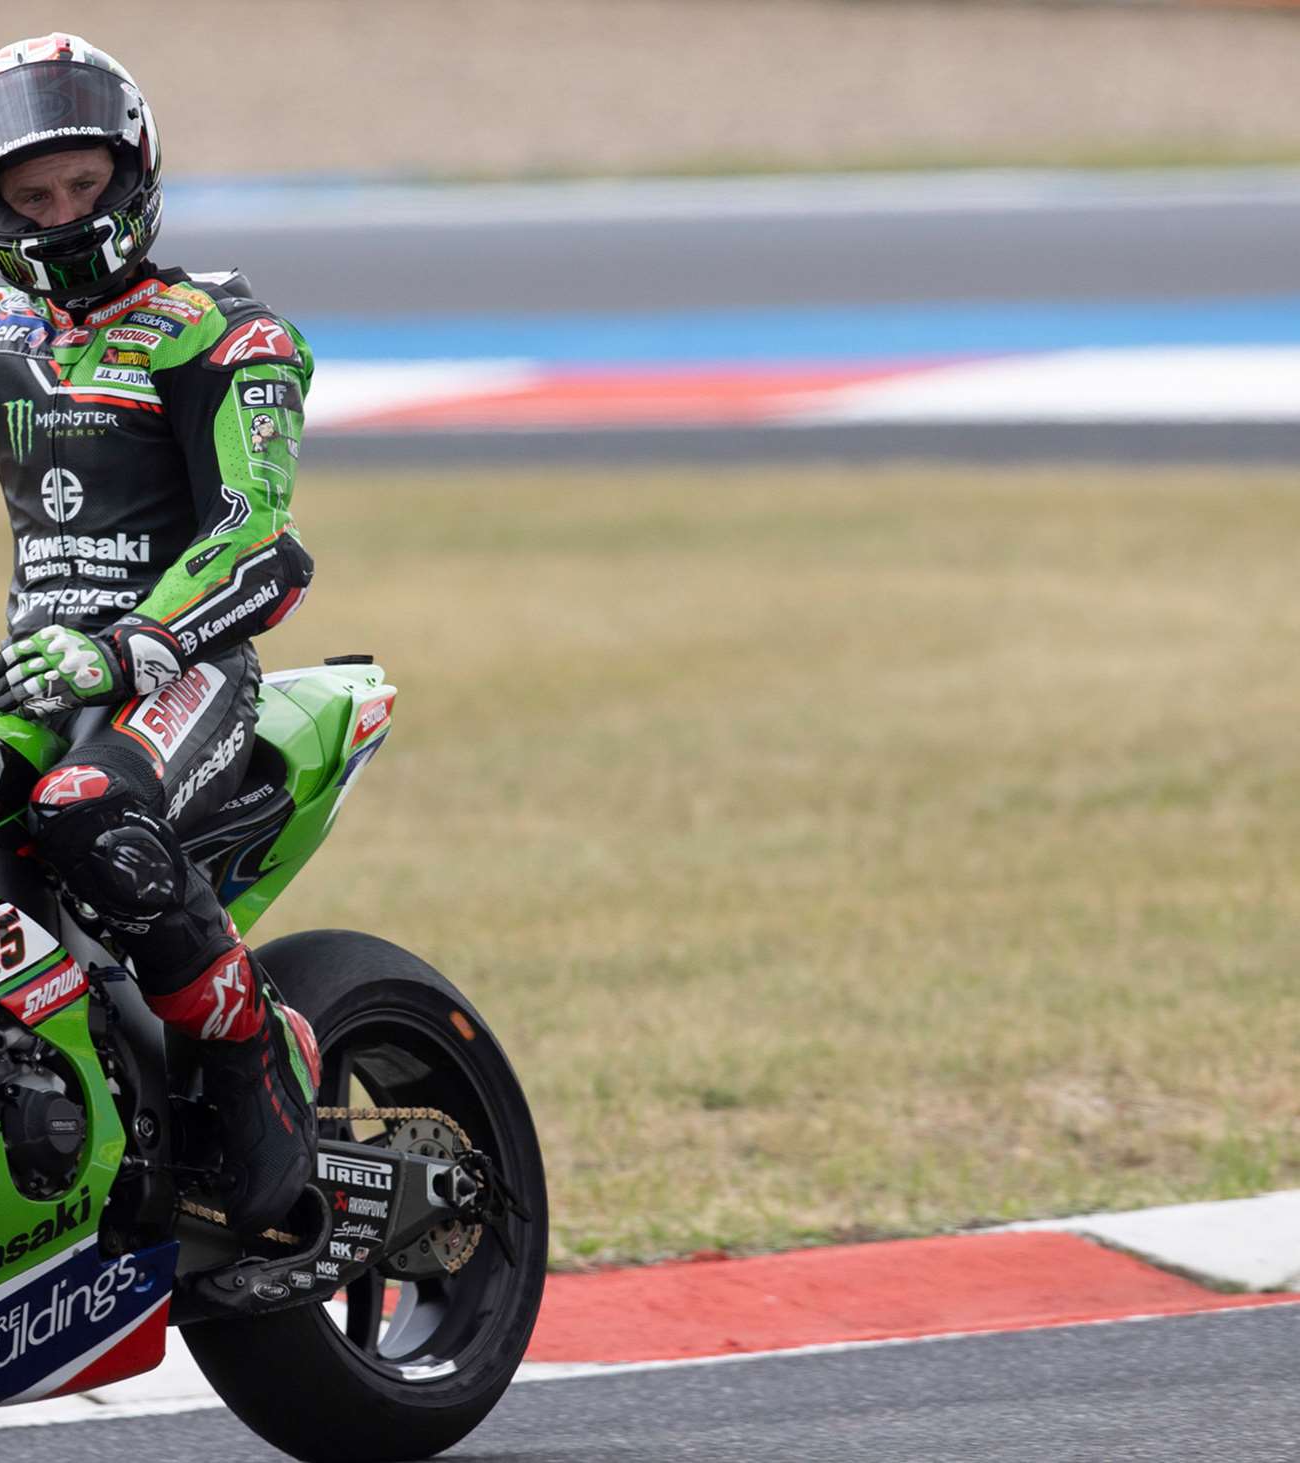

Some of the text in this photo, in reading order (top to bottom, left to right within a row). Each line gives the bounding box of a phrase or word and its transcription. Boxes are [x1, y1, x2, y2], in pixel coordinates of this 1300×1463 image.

[107, 329, 160, 345] SHOWA
[243, 383, 287, 405] elf
[35, 409, 119, 428] MONSTER
[46, 428, 106, 438] ENERGY
[19, 533, 150, 565] Kawasaki
[25, 559, 128, 581] Racing Team
[29, 588, 137, 610] PROVEC
[48, 605, 100, 615] RACING
[198, 580, 280, 642] Kawasaki
[142, 666, 212, 749] SHOWA
[240, 784, 274, 805] SEATS
[21, 962, 84, 1020] SHOWA
[317, 1153, 393, 1190] PIRELLI
[330, 1241, 351, 1256] RK
[316, 1261, 339, 1275] NGK
